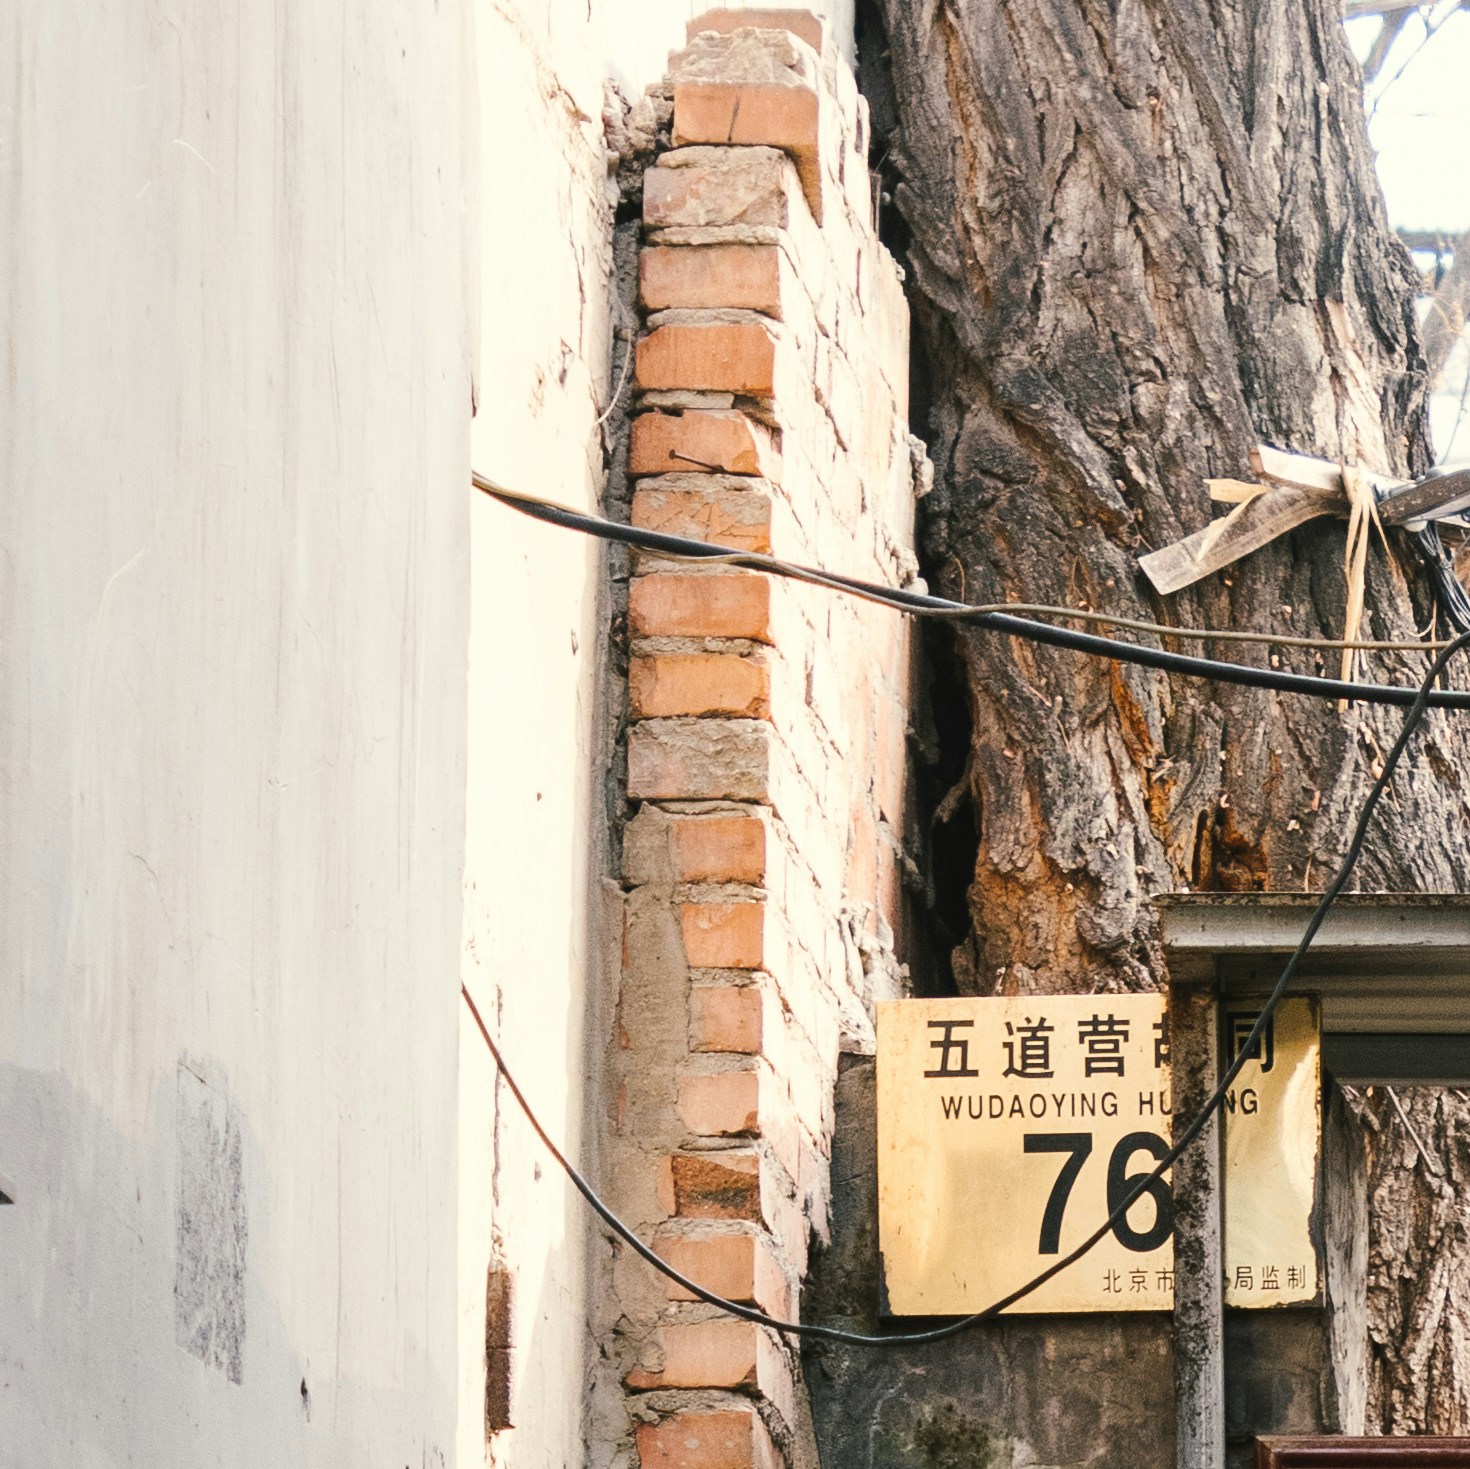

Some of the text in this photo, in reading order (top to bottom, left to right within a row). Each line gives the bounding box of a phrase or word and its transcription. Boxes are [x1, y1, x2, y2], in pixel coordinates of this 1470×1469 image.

[923, 1012, 1275, 1079] 五道营同
[940, 1088, 1258, 1120] WUDAOYING HUNG
[1023, 1130, 1174, 1255] 76
[1102, 1264, 1306, 1294] 北京市局监制
